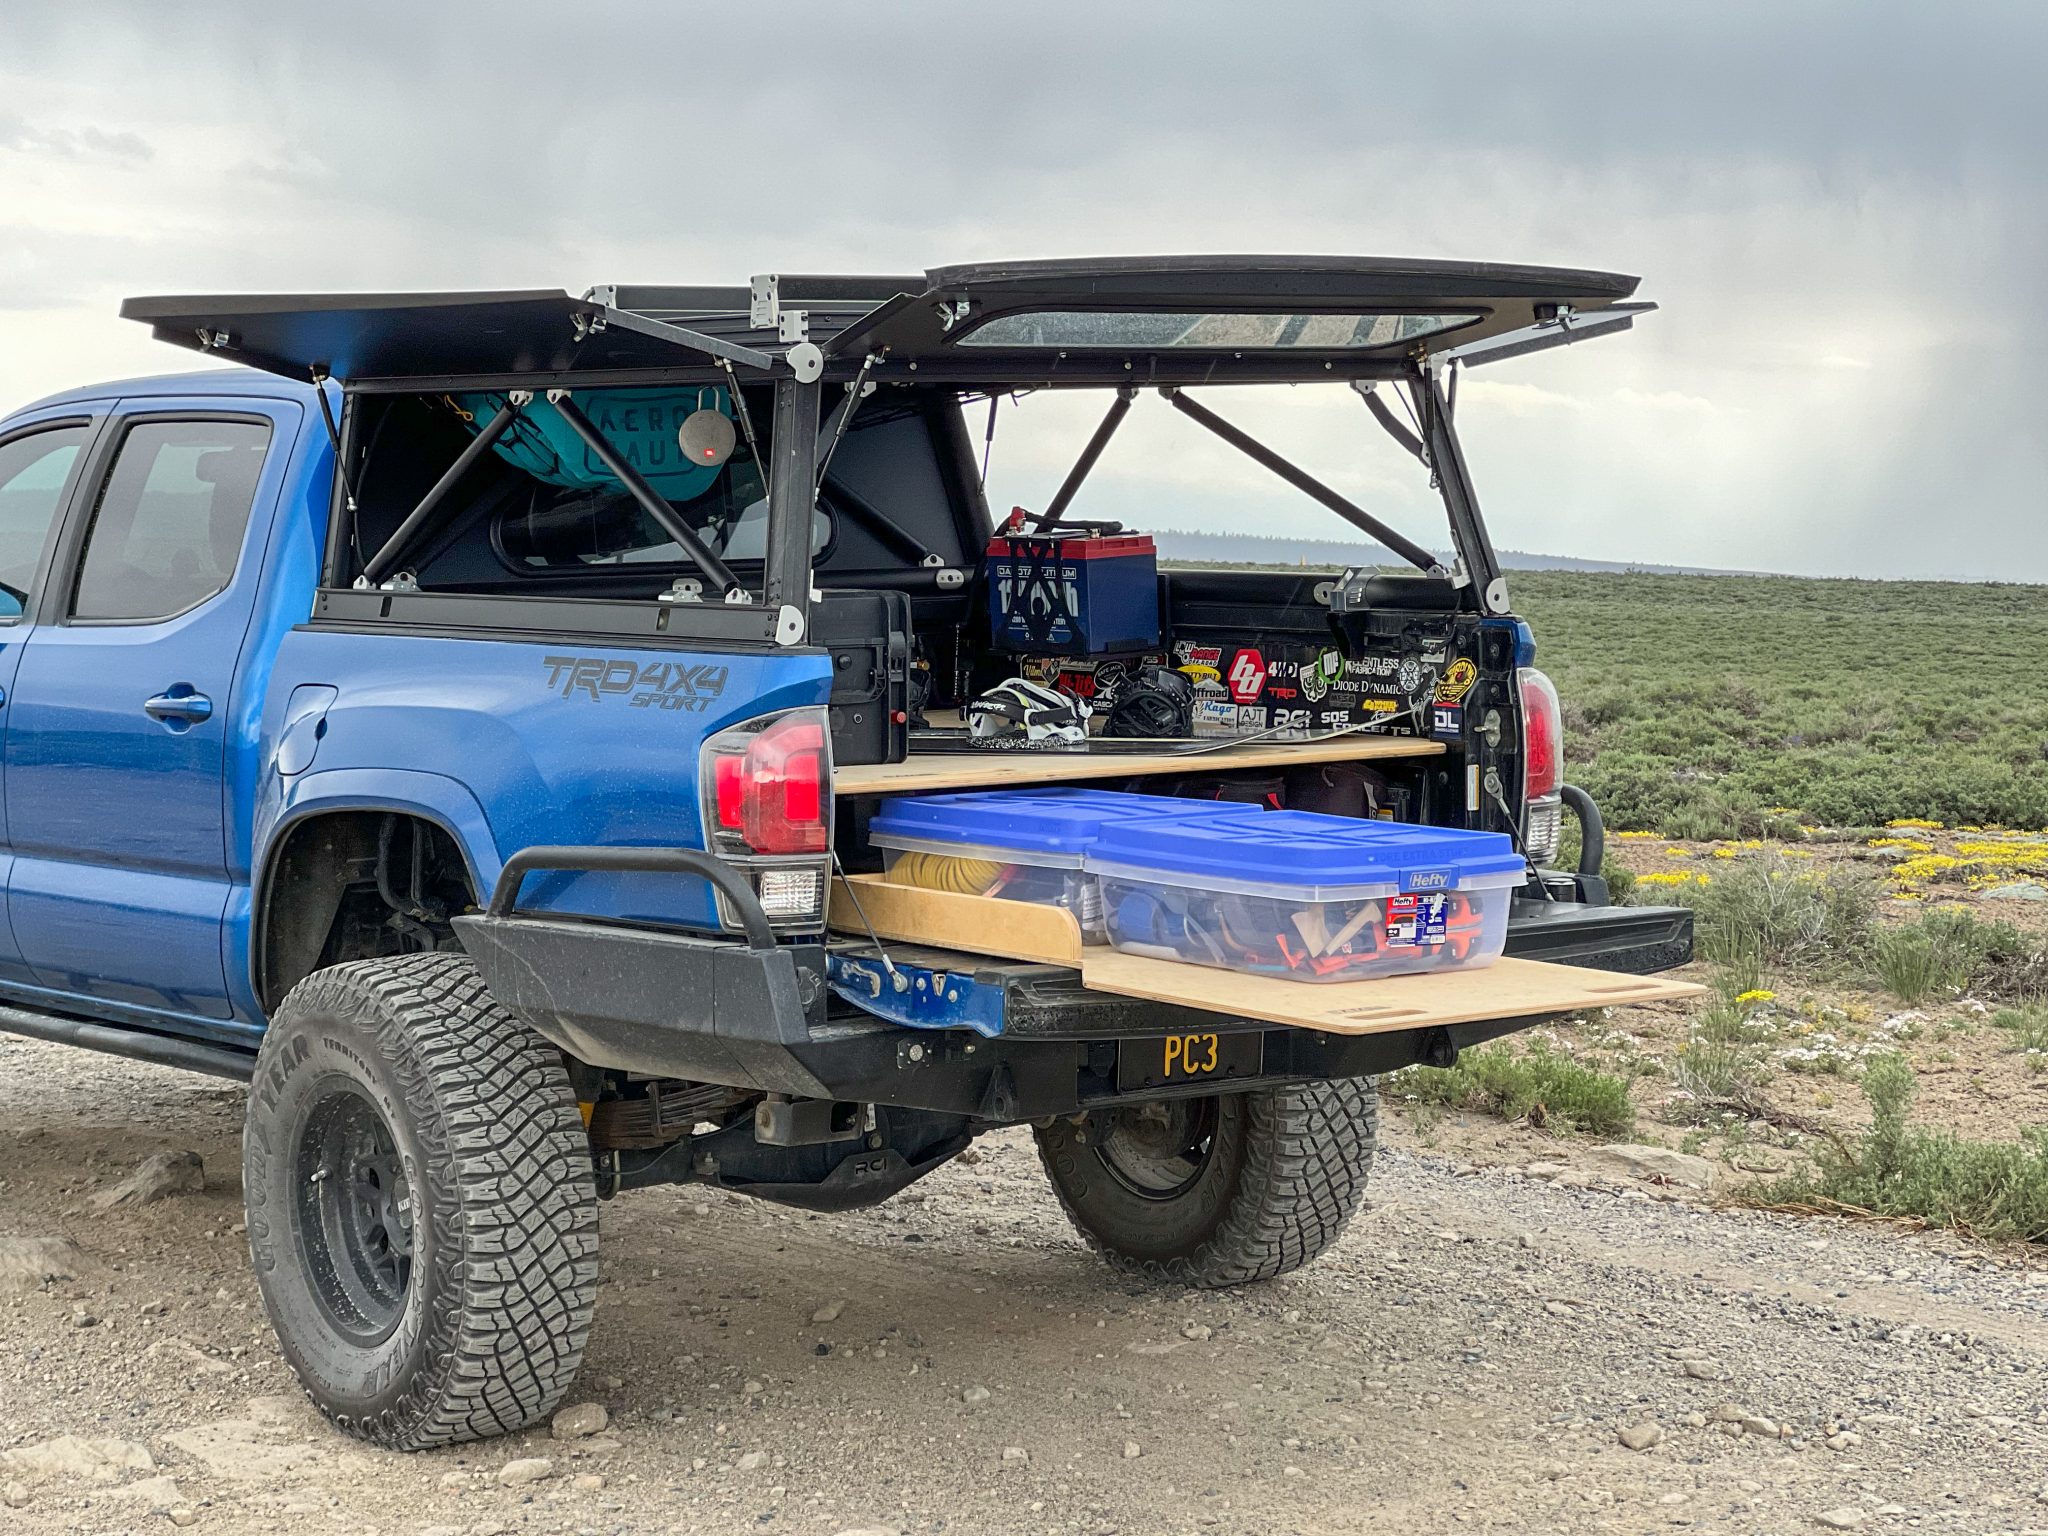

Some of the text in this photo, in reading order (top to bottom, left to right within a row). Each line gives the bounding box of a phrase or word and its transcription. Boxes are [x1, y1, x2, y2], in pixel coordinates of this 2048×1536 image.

[1190, 648, 1220, 660] RANGE
[1333, 680, 1359, 692] DIODE
[628, 692, 717, 712] SPORT
[1242, 709, 1264, 721] AJT
[1321, 710, 1349, 724] SOS
[1411, 873, 1448, 887] Hefty
[1394, 897, 1413, 905] Hefty
[323, 1037, 377, 1084] TERRITORY
[1164, 1033, 1218, 1077] PC3
[855, 1157, 887, 1175] RCI
